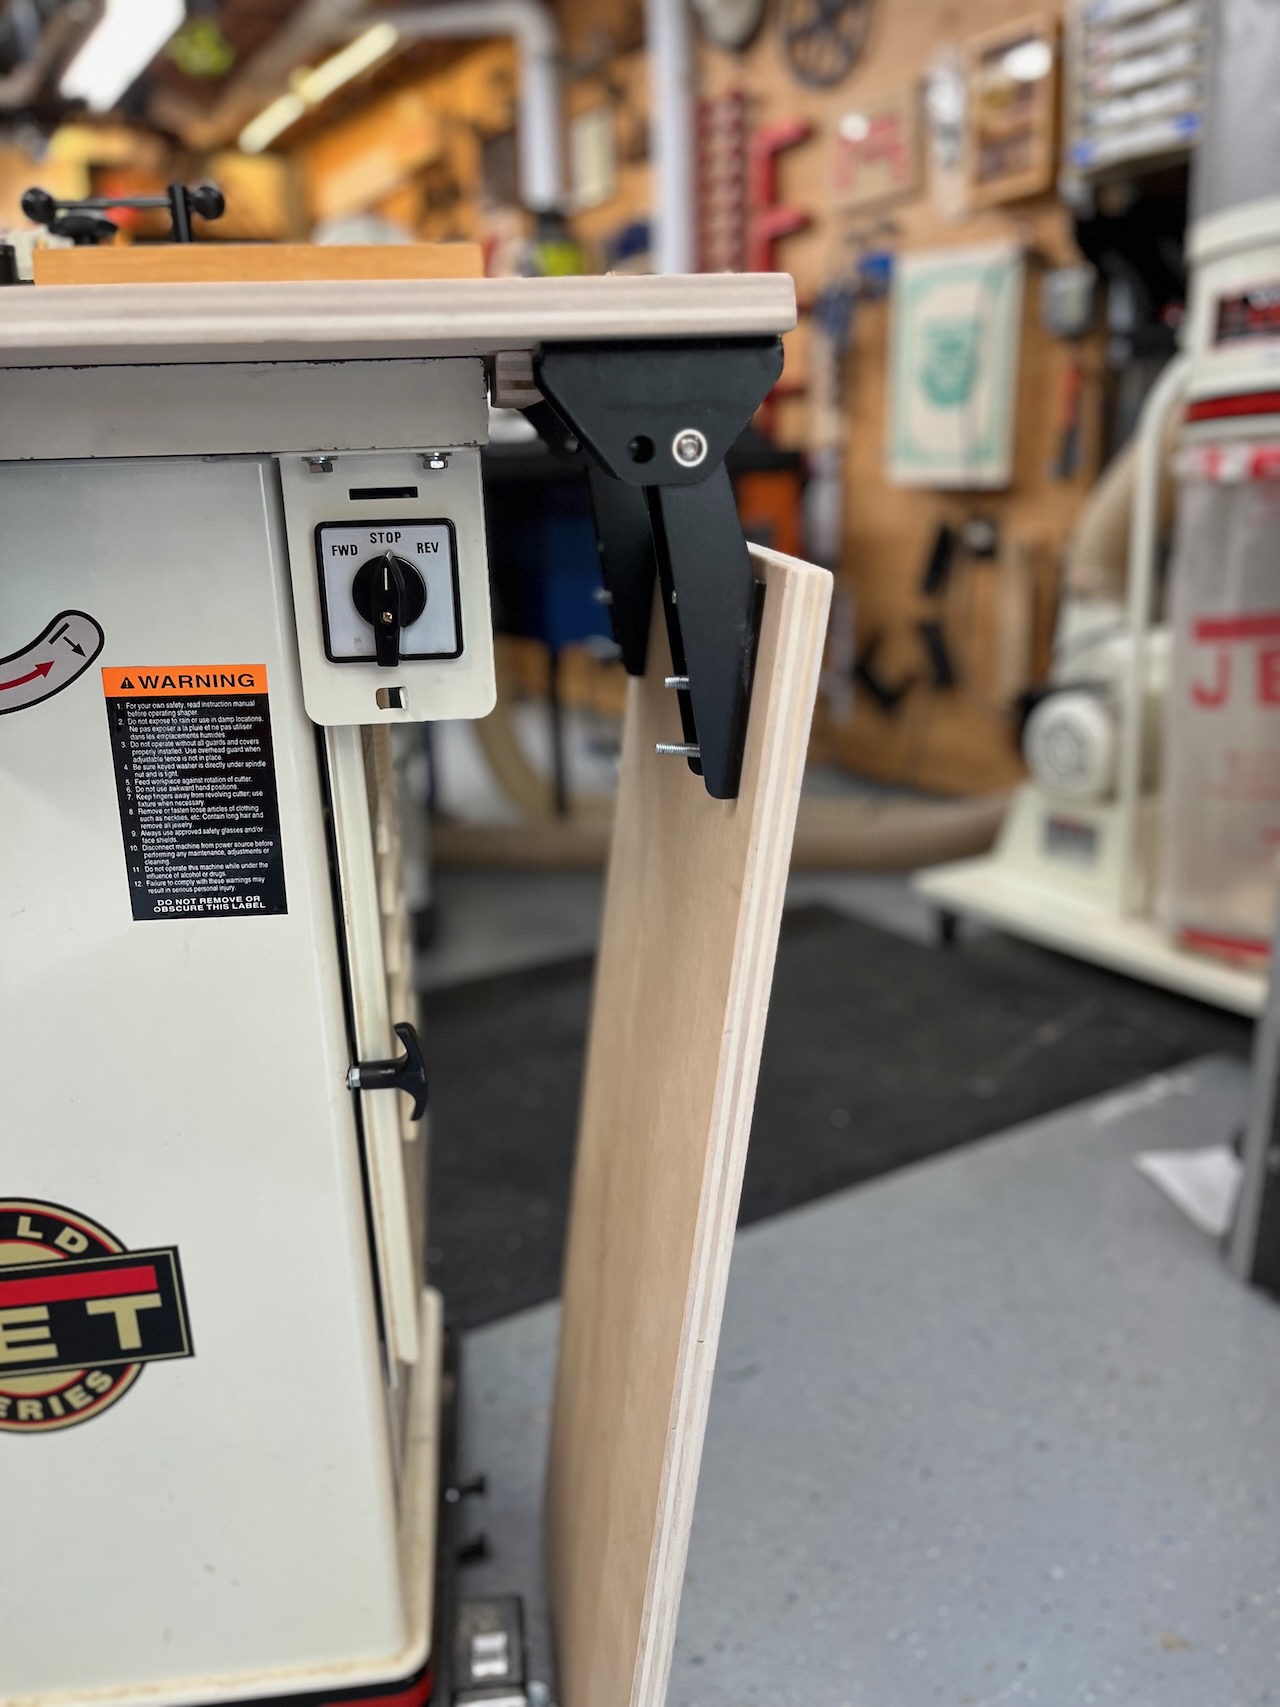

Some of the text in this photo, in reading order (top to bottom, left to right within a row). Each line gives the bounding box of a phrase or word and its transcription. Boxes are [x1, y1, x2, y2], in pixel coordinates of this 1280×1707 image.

[370, 532, 402, 543] STOP
[331, 544, 359, 556] FWD
[417, 542, 439, 554] REV
[137, 673, 255, 689] WARNING
[137, 703, 152, 711] your
[166, 702, 186, 710] safety,
[201, 700, 232, 708] instruction
[127, 710, 148, 718] before
[148, 710, 177, 719] operating
[148, 718, 171, 726] expose
[217, 716, 235, 724] damp
[139, 725, 152, 735] pas
[220, 724, 232, 732] pas
[205, 739, 226, 748] guards
[227, 738, 239, 746] and
[198, 746, 226, 754] overhead
[226, 746, 244, 755] guard
[204, 761, 226, 770] directly
[245, 760, 266, 769] spindle
[134, 778, 151, 786] Feed
[181, 777, 204, 786] against
[204, 776, 227, 784] rotation
[136, 793, 153, 802] Keep
[205, 791, 232, 800] revolving
[236, 805, 260, 813] clothing
[140, 822, 164, 830] remove
[174, 828, 202, 837] approved
[202, 828, 220, 836] safety
[221, 827, 244, 836] glasses
[142, 844, 175, 852] Disconnect
[215, 842, 234, 850] power
[143, 851, 176, 860] performing
[175, 850, 188, 859] any
[226, 848, 262, 857] adjustments
[180, 871, 202, 879] alcohol
[146, 880, 167, 888] Failure
[173, 879, 196, 887] comply
[195, 878, 208, 886] with
[225, 876, 252, 885] warnings
[147, 887, 165, 895] result
[171, 886, 193, 894] serious
[193, 885, 219, 894] personal
[199, 896, 243, 904] REMOVE
[153, 904, 204, 913] OBSCURE
[232, 902, 266, 910] LABEL
